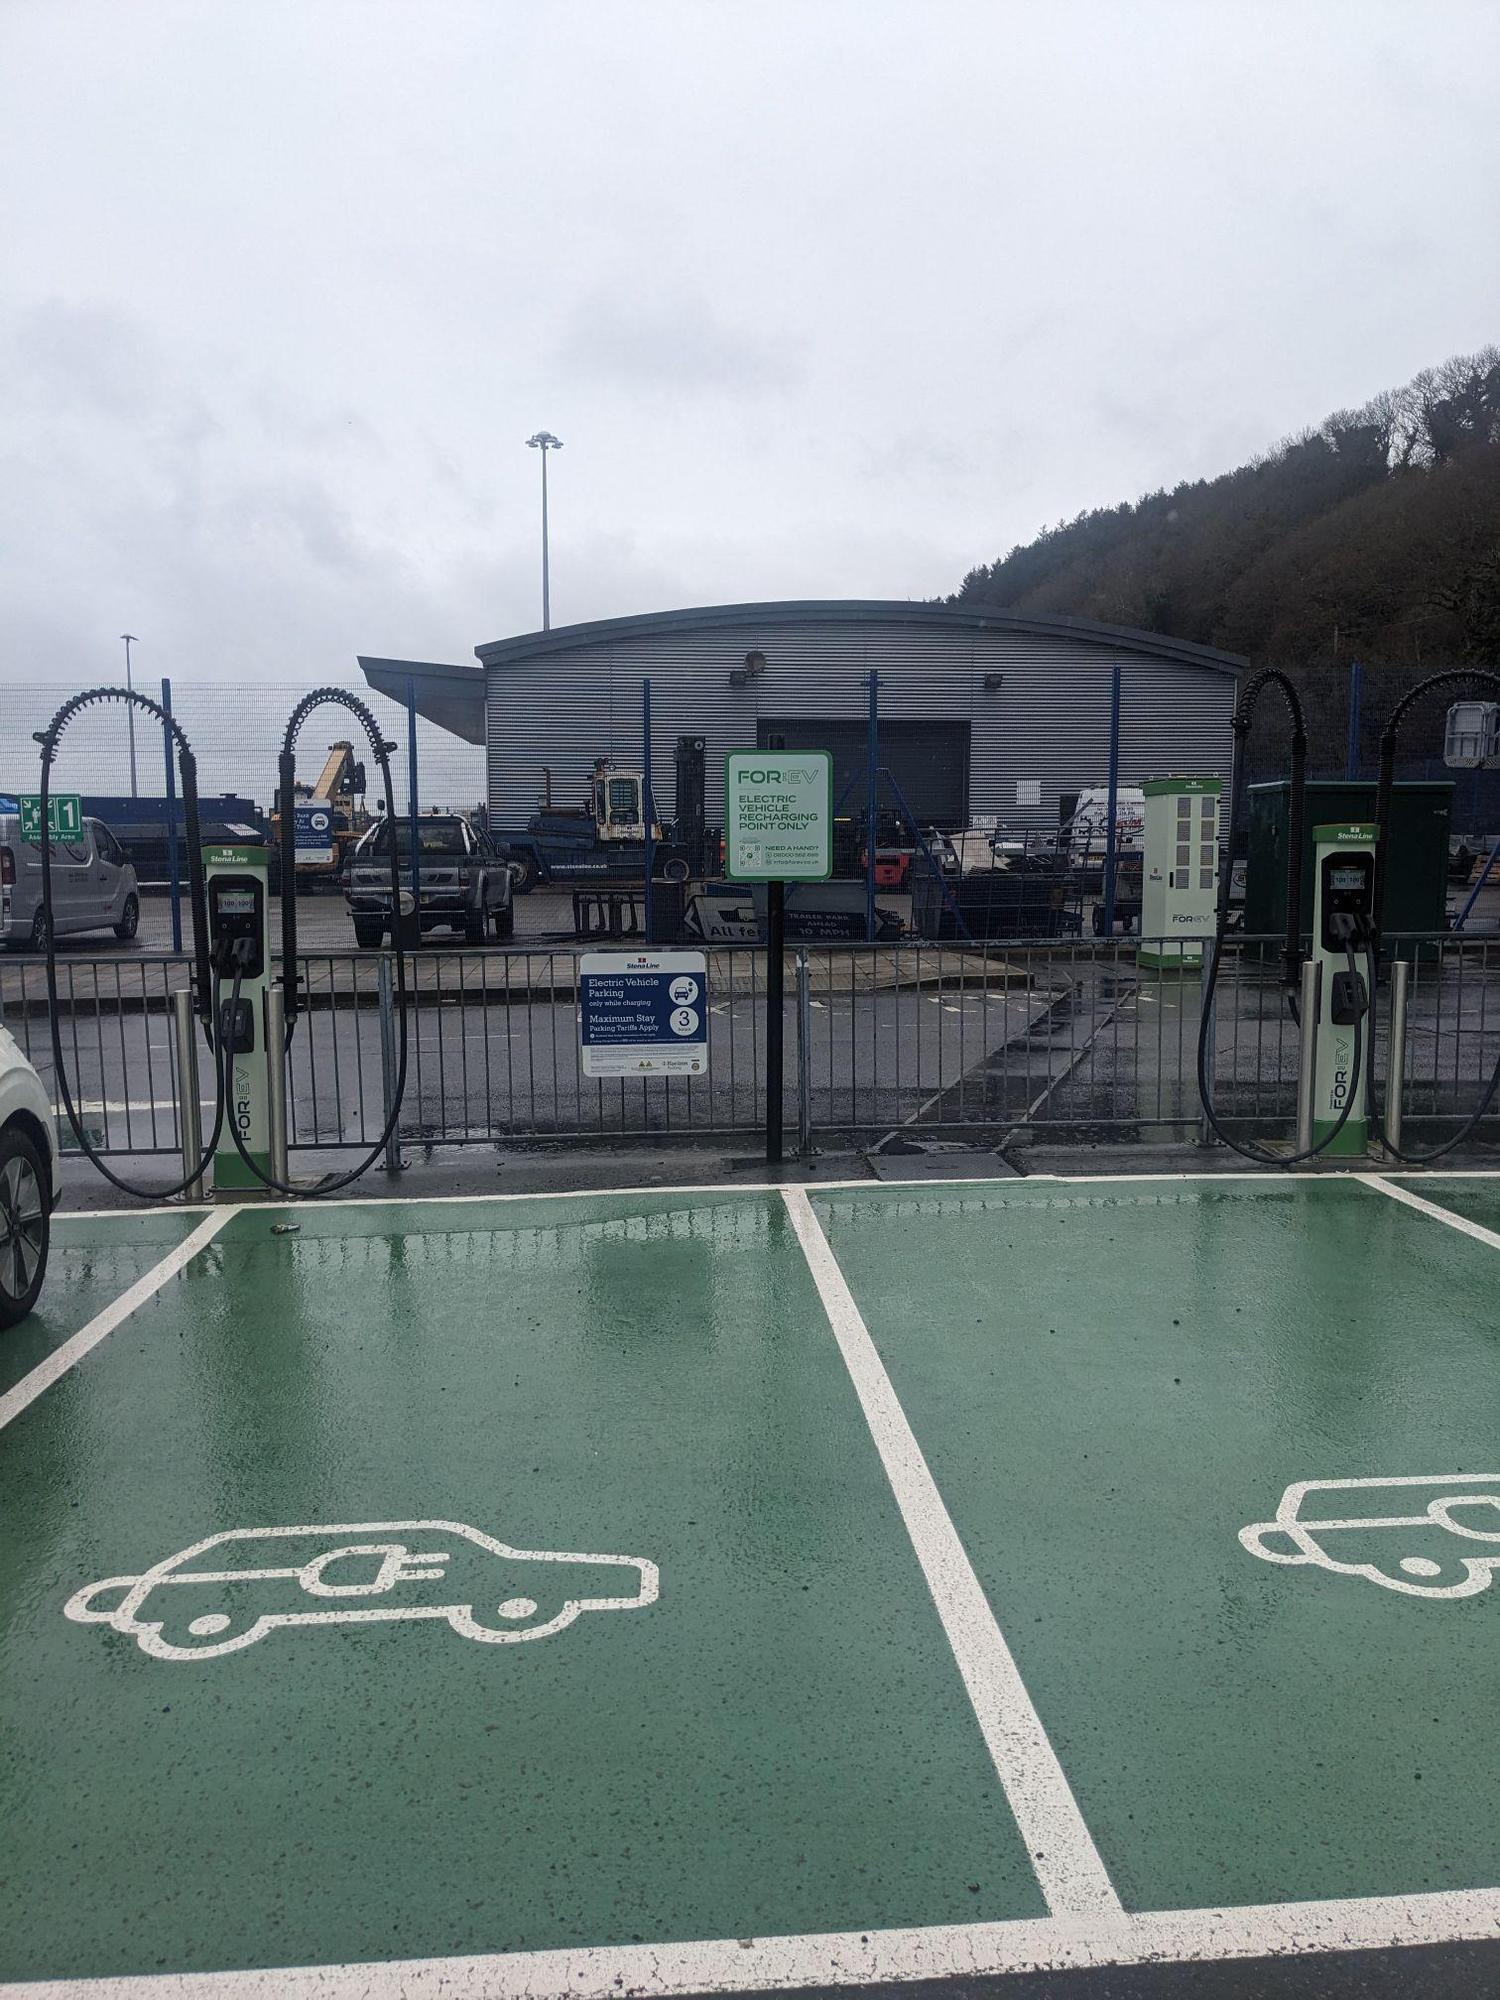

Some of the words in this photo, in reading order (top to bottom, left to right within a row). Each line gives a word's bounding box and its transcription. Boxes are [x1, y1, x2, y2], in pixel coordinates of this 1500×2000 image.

[738, 795, 797, 803] ELECTRIC
[738, 804, 790, 812] VEHICLE
[62, 801, 75, 828] 1
[738, 813, 818, 821] RECHARGING
[739, 822, 776, 830] POINT
[777, 822, 809, 830] ONLY
[710, 926, 735, 937] All
[588, 979, 624, 987] Electric
[625, 978, 660, 986] Vehicle
[588, 989, 625, 999] Parking
[622, 999, 651, 1007] charging
[589, 1015, 635, 1023] Maximum
[636, 1014, 656, 1023] Stay
[678, 1010, 690, 1027] 3
[638, 1024, 660, 1032] Apply
